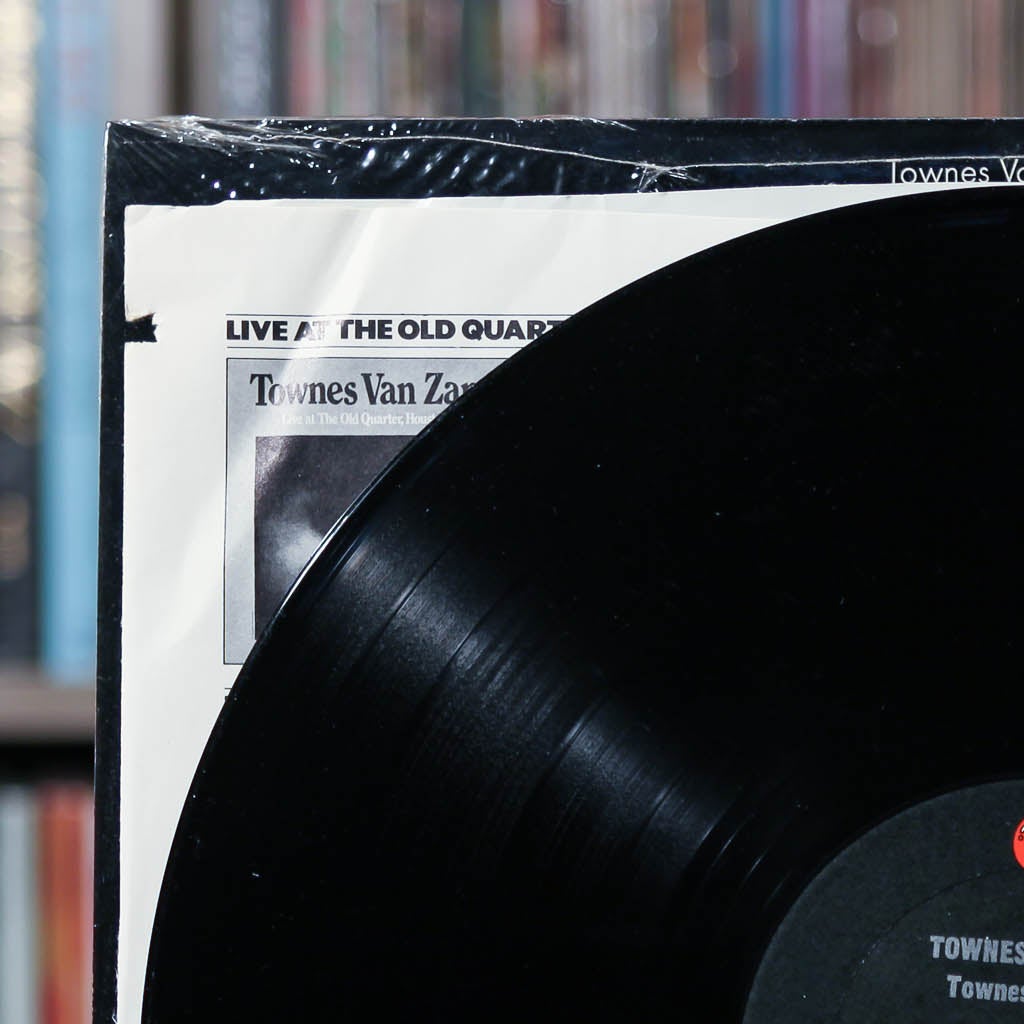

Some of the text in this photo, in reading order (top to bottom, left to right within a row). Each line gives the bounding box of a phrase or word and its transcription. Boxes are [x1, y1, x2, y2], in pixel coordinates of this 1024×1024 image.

[890, 159, 990, 184] Townes
[226, 320, 289, 341] LIVE
[293, 320, 328, 341] AT
[336, 319, 393, 340] THE
[397, 319, 456, 340] OLD
[250, 373, 359, 406] Townes
[361, 373, 416, 405] Van
[319, 412, 339, 425] The
[341, 411, 360, 425] Old
